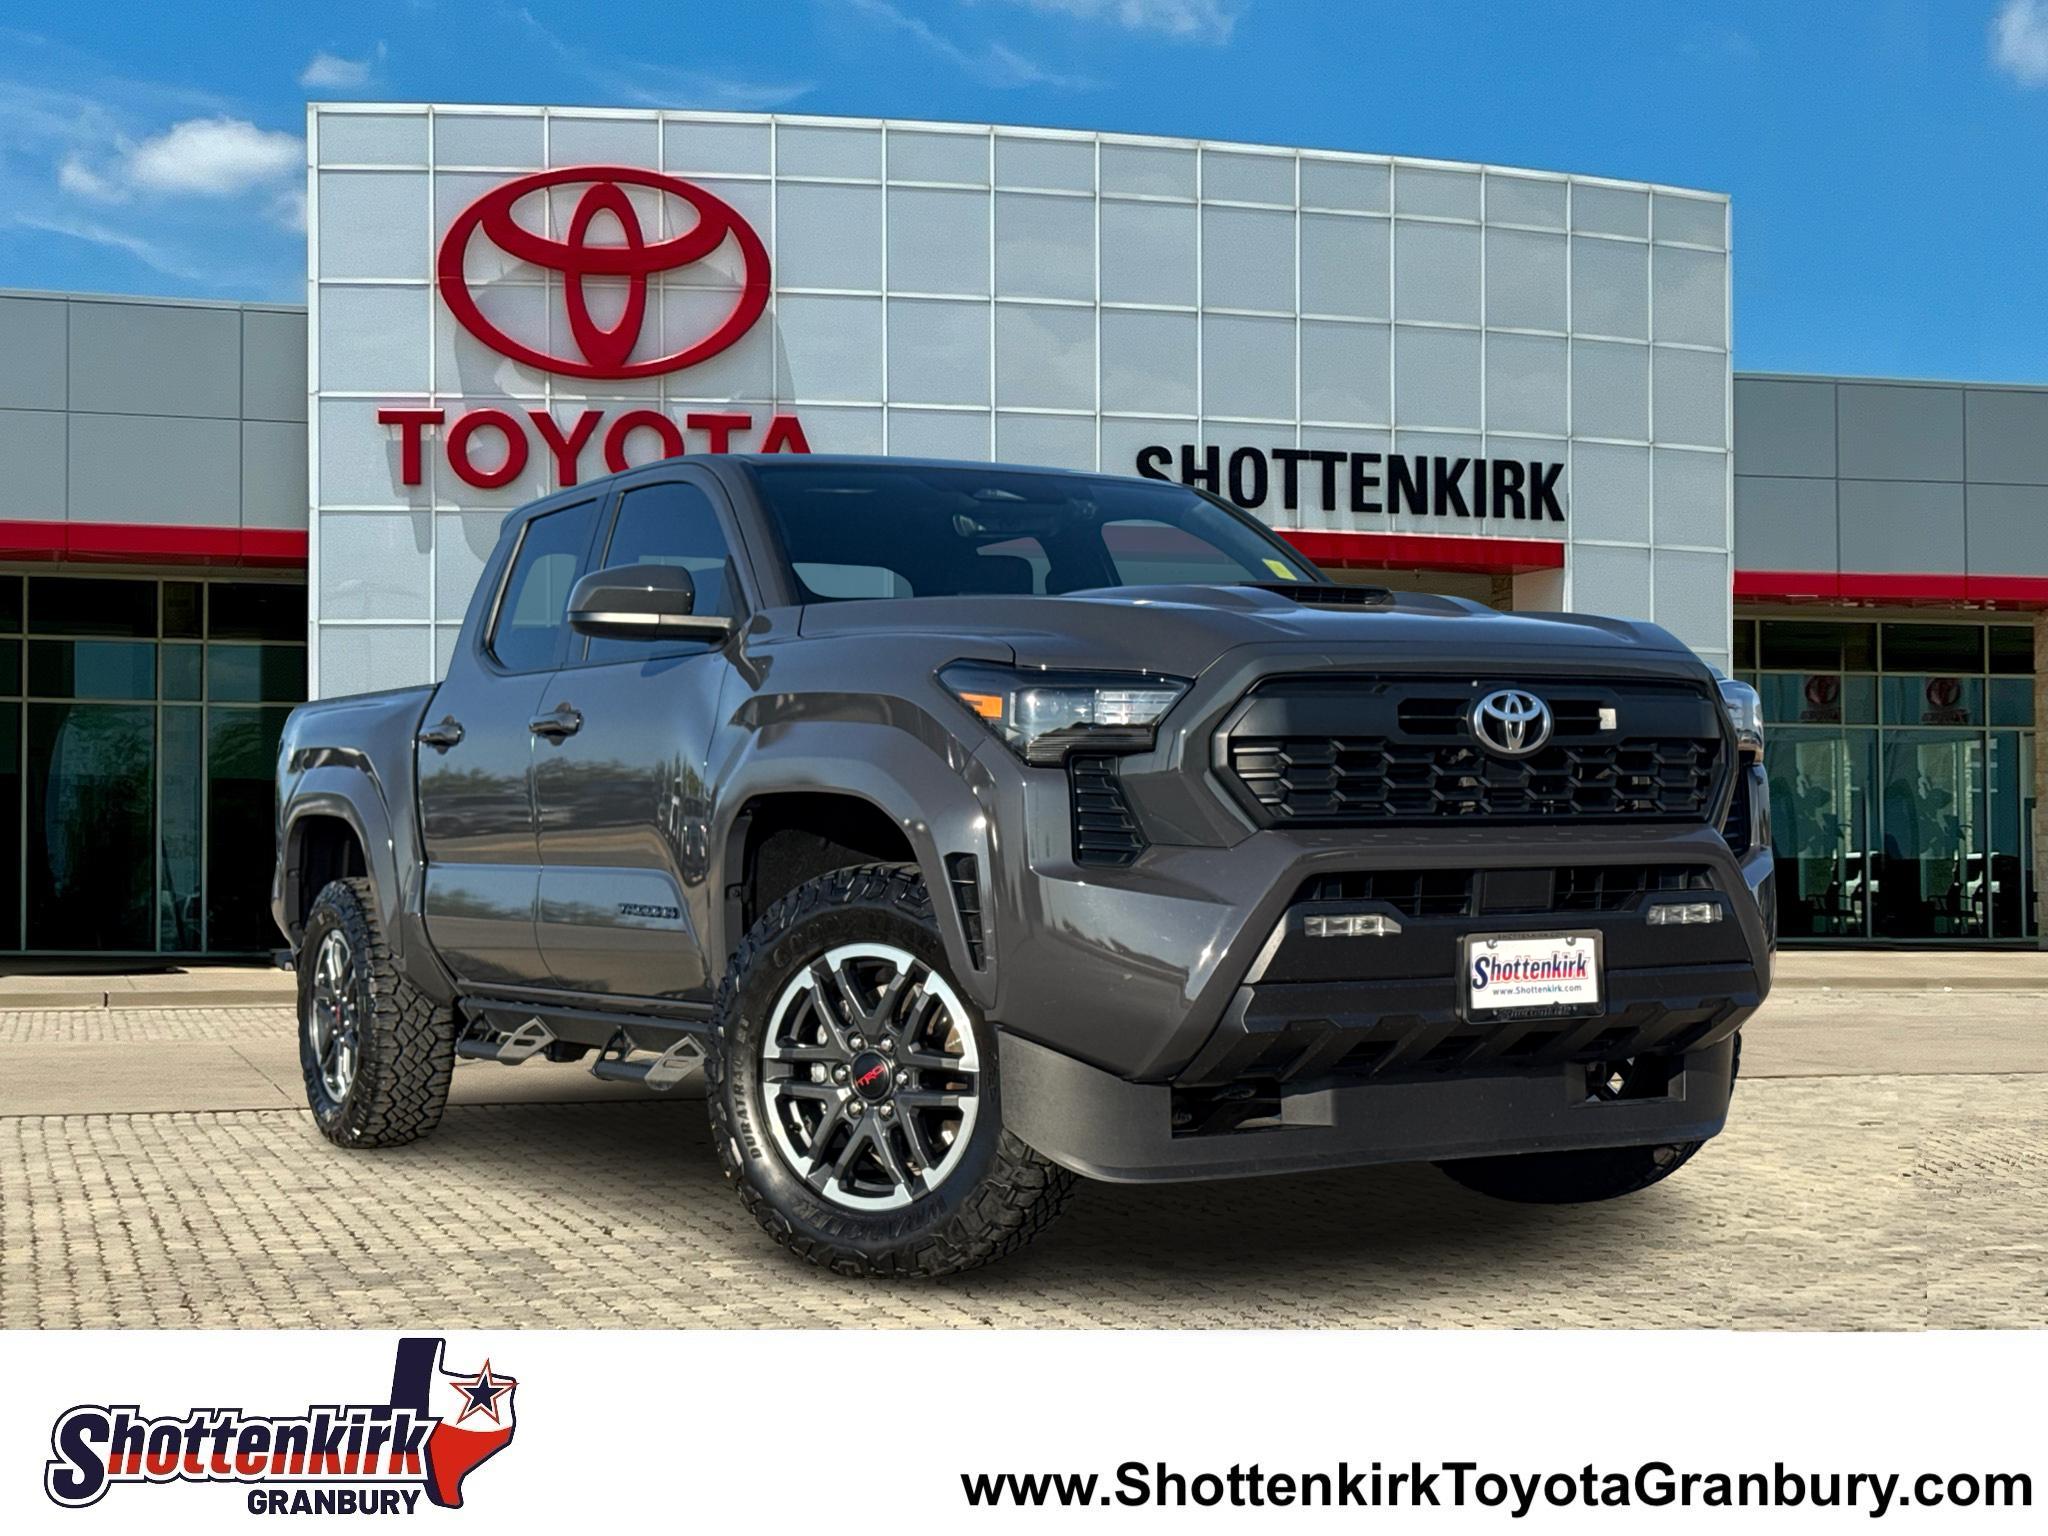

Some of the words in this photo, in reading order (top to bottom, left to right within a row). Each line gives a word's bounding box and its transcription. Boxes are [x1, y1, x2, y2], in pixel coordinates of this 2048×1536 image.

[1136, 445, 1565, 521] SHOTTENKIRK
[1472, 951, 1588, 990] Shottenkirk
[1492, 984, 1582, 996] www.Shottenkirk.com
